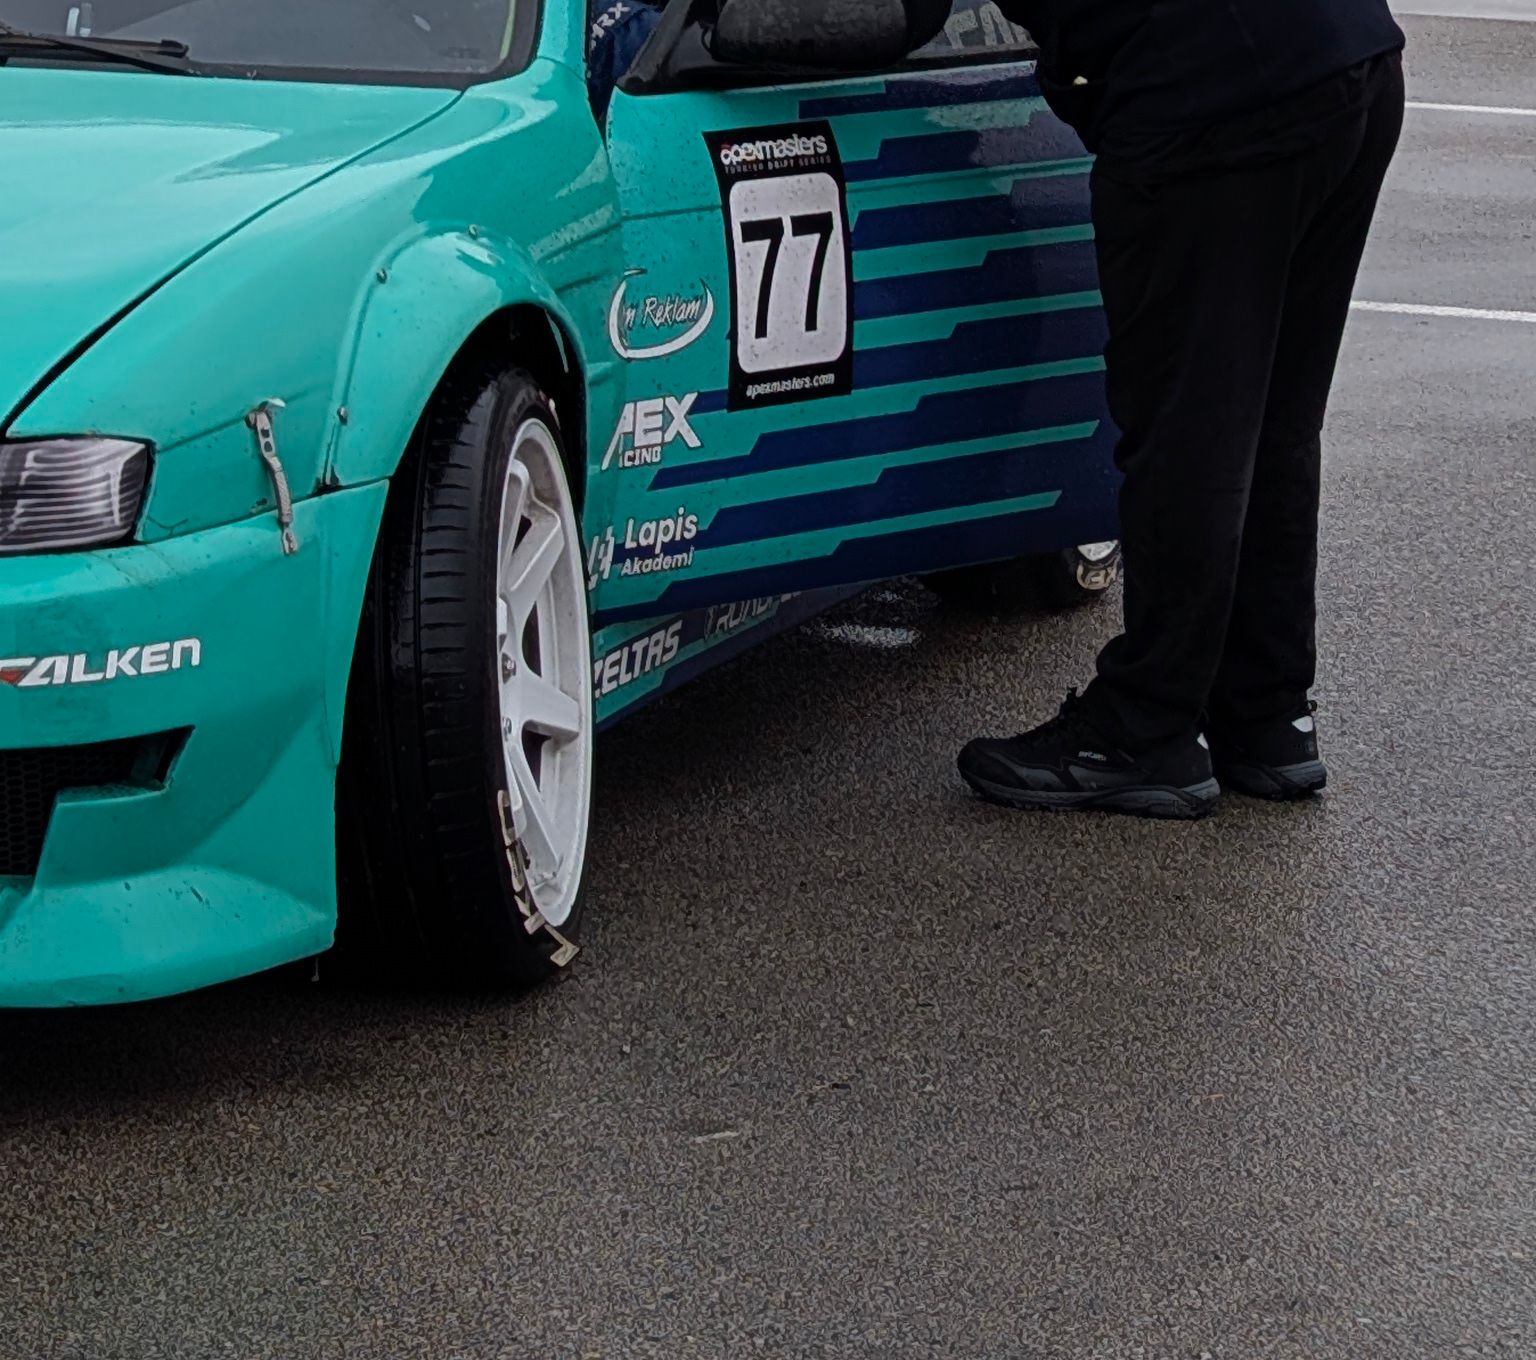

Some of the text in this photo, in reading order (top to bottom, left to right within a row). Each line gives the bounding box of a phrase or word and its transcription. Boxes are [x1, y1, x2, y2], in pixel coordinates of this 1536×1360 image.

[719, 133, 829, 167] apexmasters
[739, 210, 834, 339] 77
[643, 295, 701, 327] Reklam
[746, 373, 835, 400] apexmasters.com
[624, 506, 699, 554] Lapis
[620, 544, 696, 577] Akademi
